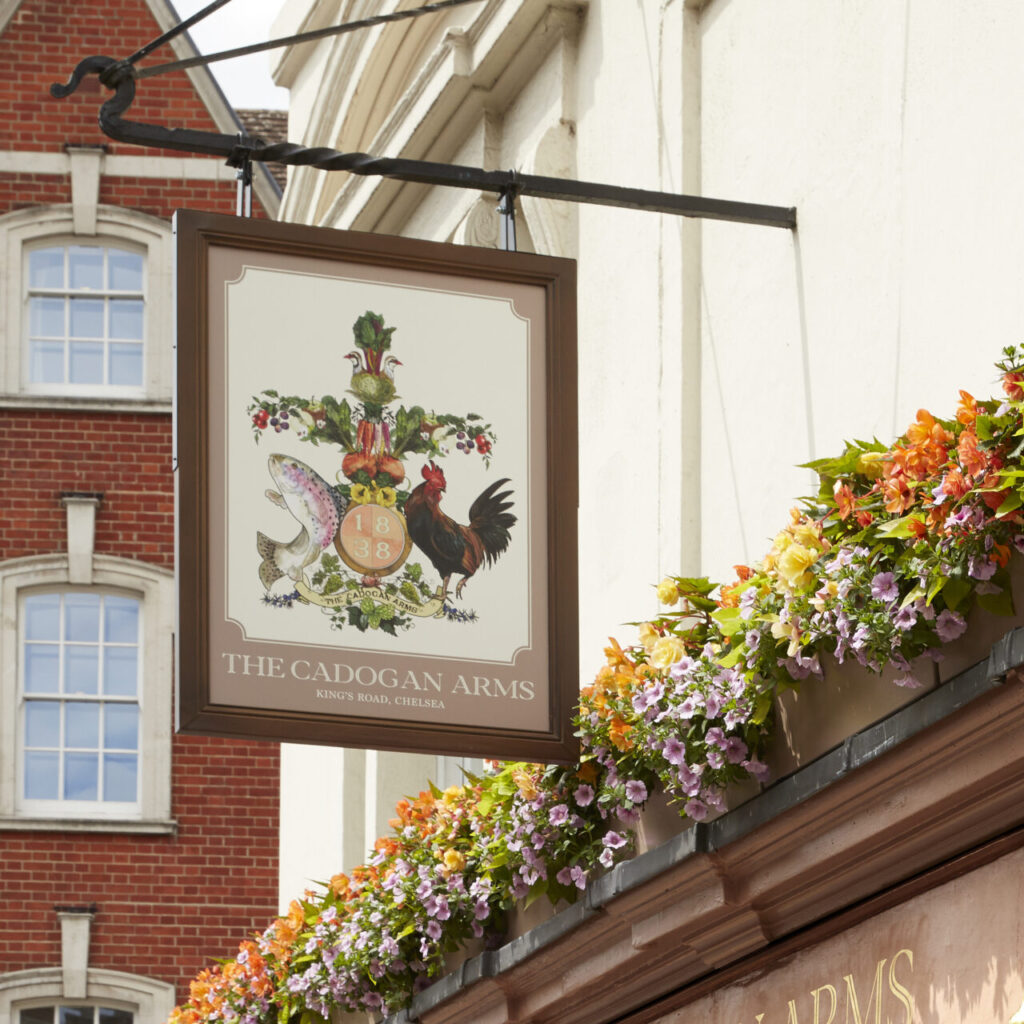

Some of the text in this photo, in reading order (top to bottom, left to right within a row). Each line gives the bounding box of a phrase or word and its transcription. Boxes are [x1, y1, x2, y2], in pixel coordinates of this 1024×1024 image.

[325, 597, 344, 605] THE
[393, 598, 418, 613] ARMS
[222, 652, 536, 701] THE CADOGAN ARMS
[316, 688, 446, 709] KING'S ROAD, CHELSEA
